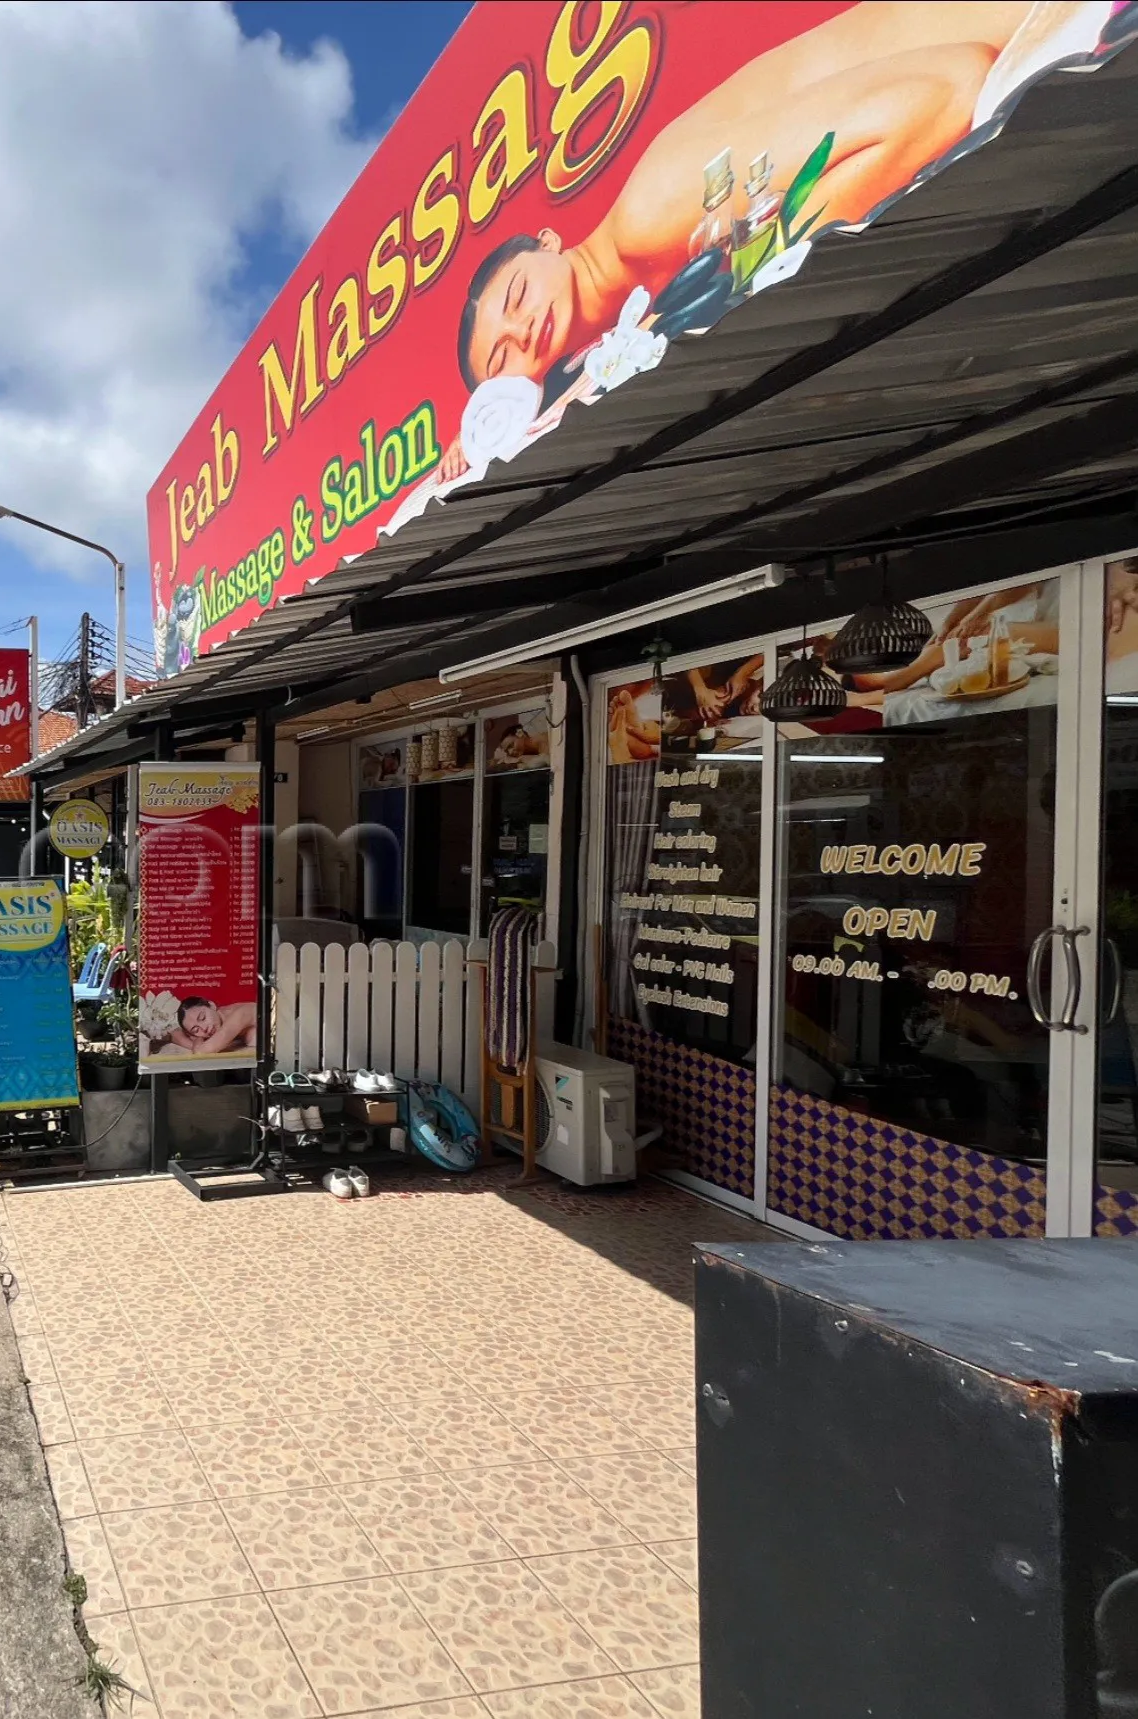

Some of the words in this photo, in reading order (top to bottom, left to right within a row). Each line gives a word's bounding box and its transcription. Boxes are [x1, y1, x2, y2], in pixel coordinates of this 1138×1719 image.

[165, 413, 240, 581] Jeab
[259, 1, 658, 459] Massag
[198, 527, 286, 630] Massage
[291, 496, 314, 565] &
[321, 400, 441, 542] Salon
[145, 778, 179, 797] Jeab
[181, 782, 232, 803] Massage
[654, 768, 680, 788] Wash
[680, 765, 699, 786] and
[700, 764, 720, 789] dry
[668, 801, 702, 818] Steam
[57, 820, 103, 833] OASIS
[653, 832, 675, 850] Hair
[675, 829, 717, 853] coloring
[699, 861, 723, 882] hair
[820, 842, 987, 876] WELCOME
[654, 893, 673, 911] For
[672, 895, 695, 913] Men
[695, 894, 716, 915] and
[715, 898, 756, 919] Women
[842, 905, 937, 941] OPEN
[633, 952, 651, 971] Gel
[682, 959, 705, 980] PVC
[705, 962, 735, 985] Nails
[792, 953, 845, 977] 09.00
[846, 960, 884, 982] AM.
[969, 972, 1019, 1000] PM.
[637, 983, 673, 1006] Eyelash
[673, 989, 730, 1017] Extensions
